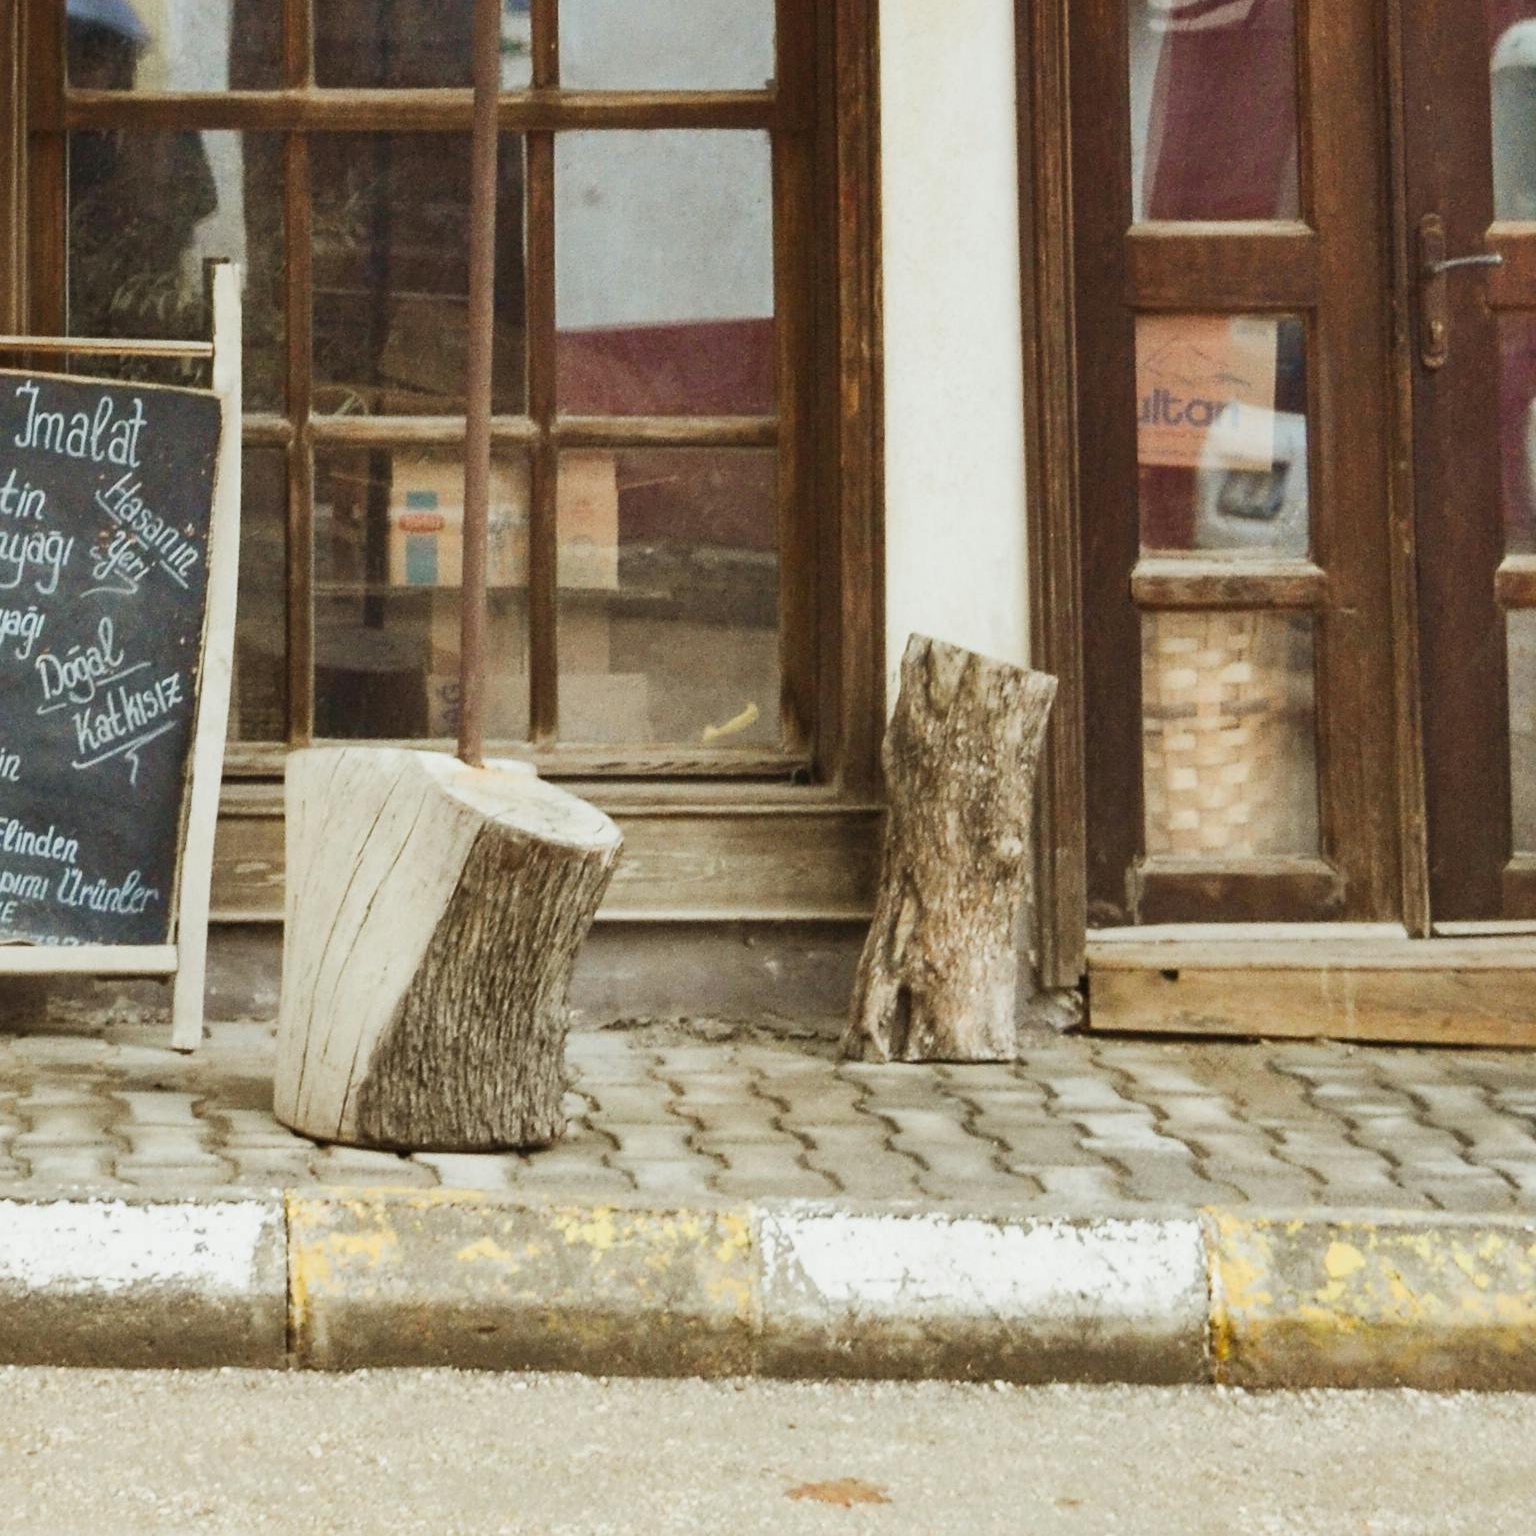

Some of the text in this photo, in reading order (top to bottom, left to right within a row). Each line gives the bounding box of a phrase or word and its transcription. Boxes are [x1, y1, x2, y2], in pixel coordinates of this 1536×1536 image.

[15, 380, 147, 468] İmalat
[91, 530, 156, 581] Yeri
[35, 616, 125, 704] Doğal
[71, 672, 183, 755] Katkısız
[56, 867, 160, 915] Ürünler
